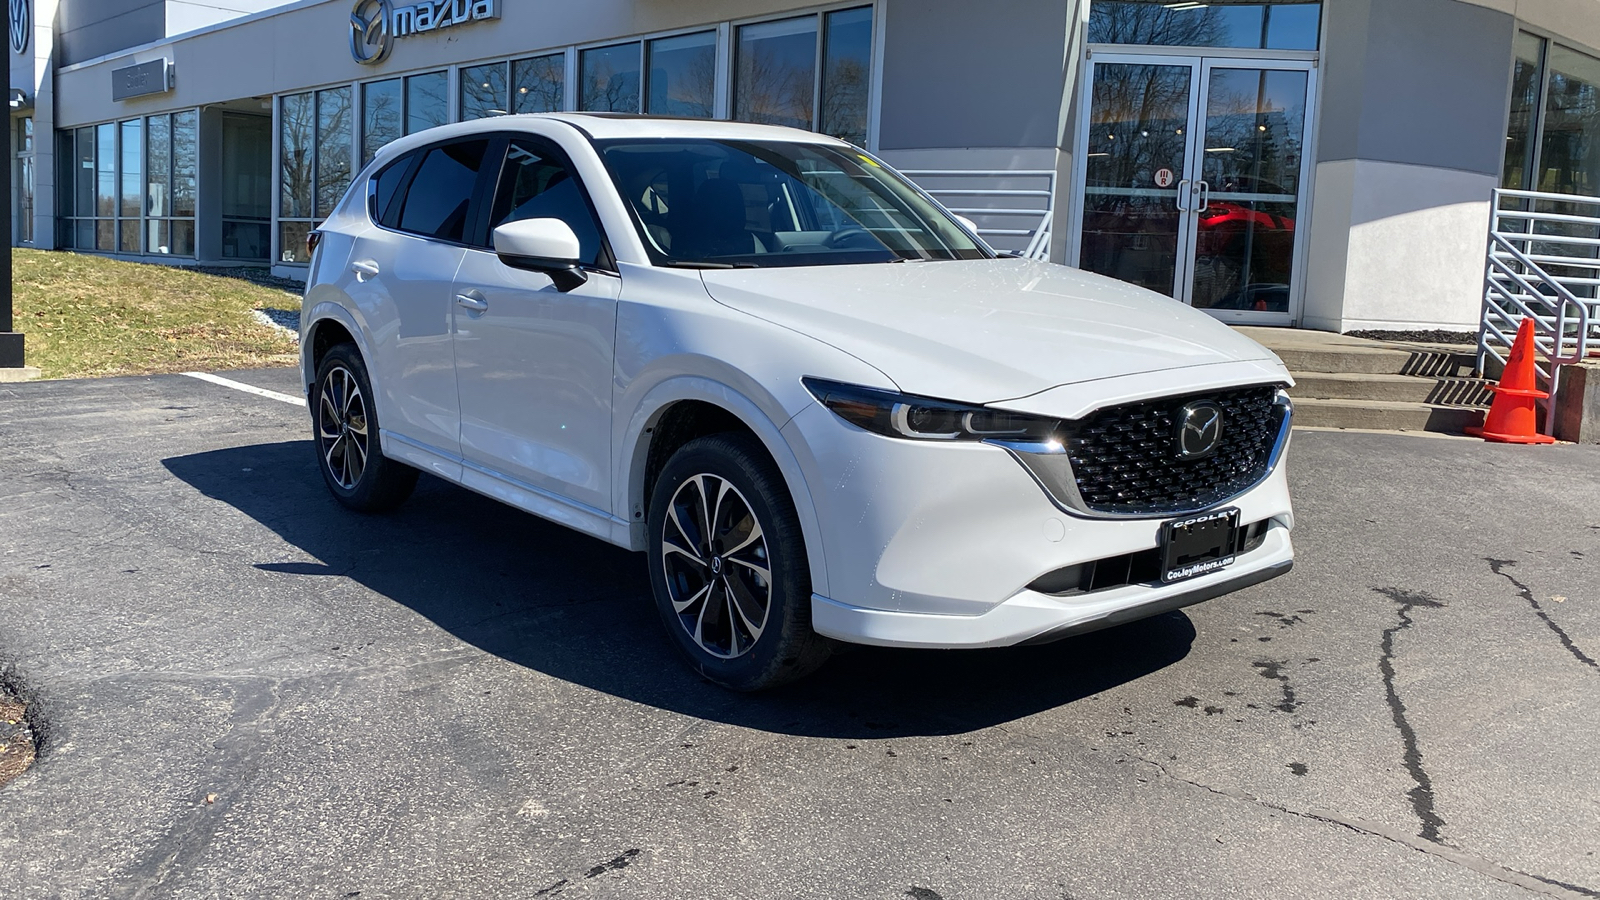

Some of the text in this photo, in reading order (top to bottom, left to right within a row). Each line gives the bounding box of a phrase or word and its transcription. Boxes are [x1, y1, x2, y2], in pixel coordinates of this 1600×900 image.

[393, 0, 493, 38] mazda
[1173, 509, 1239, 528] COOLEY
[1167, 557, 1234, 580] CooleyMotors.com
